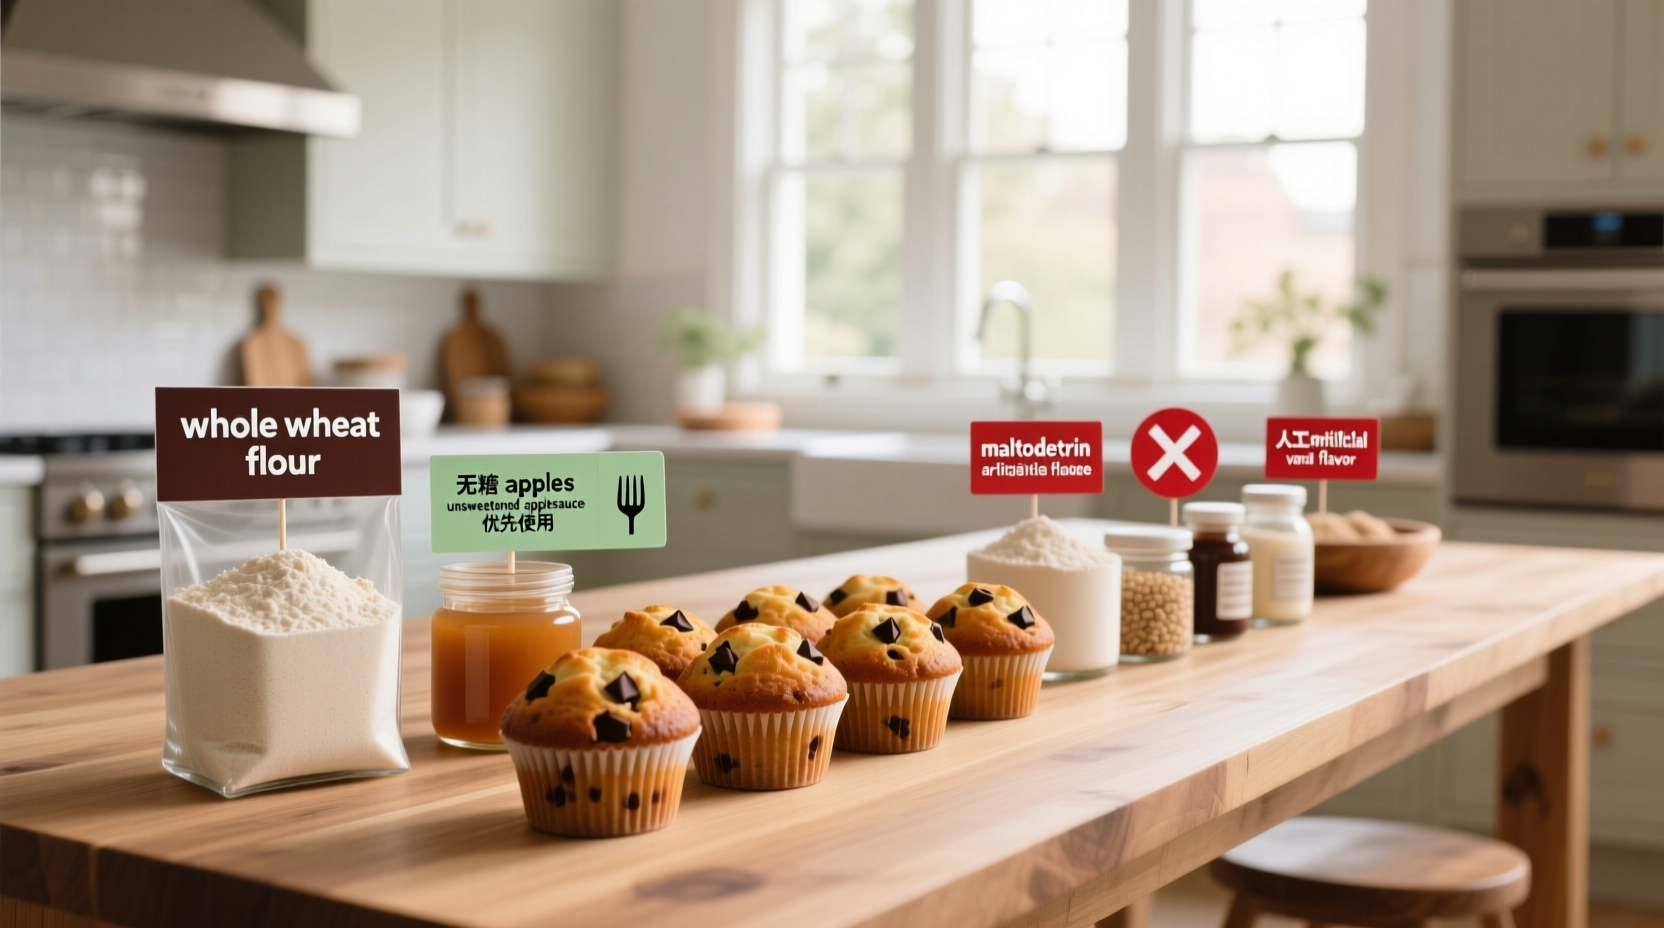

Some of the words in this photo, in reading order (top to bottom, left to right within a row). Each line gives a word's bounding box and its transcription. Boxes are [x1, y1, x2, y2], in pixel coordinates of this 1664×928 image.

[180, 408, 278, 439] whole
[284, 408, 381, 438] wheat
[981, 436, 1091, 457] maltodetrin
[1319, 449, 1356, 466] flavor
[245, 445, 321, 476] flour
[456, 473, 499, 496] 无糖
[505, 471, 575, 498] apples
[482, 512, 554, 533] 优先使用
